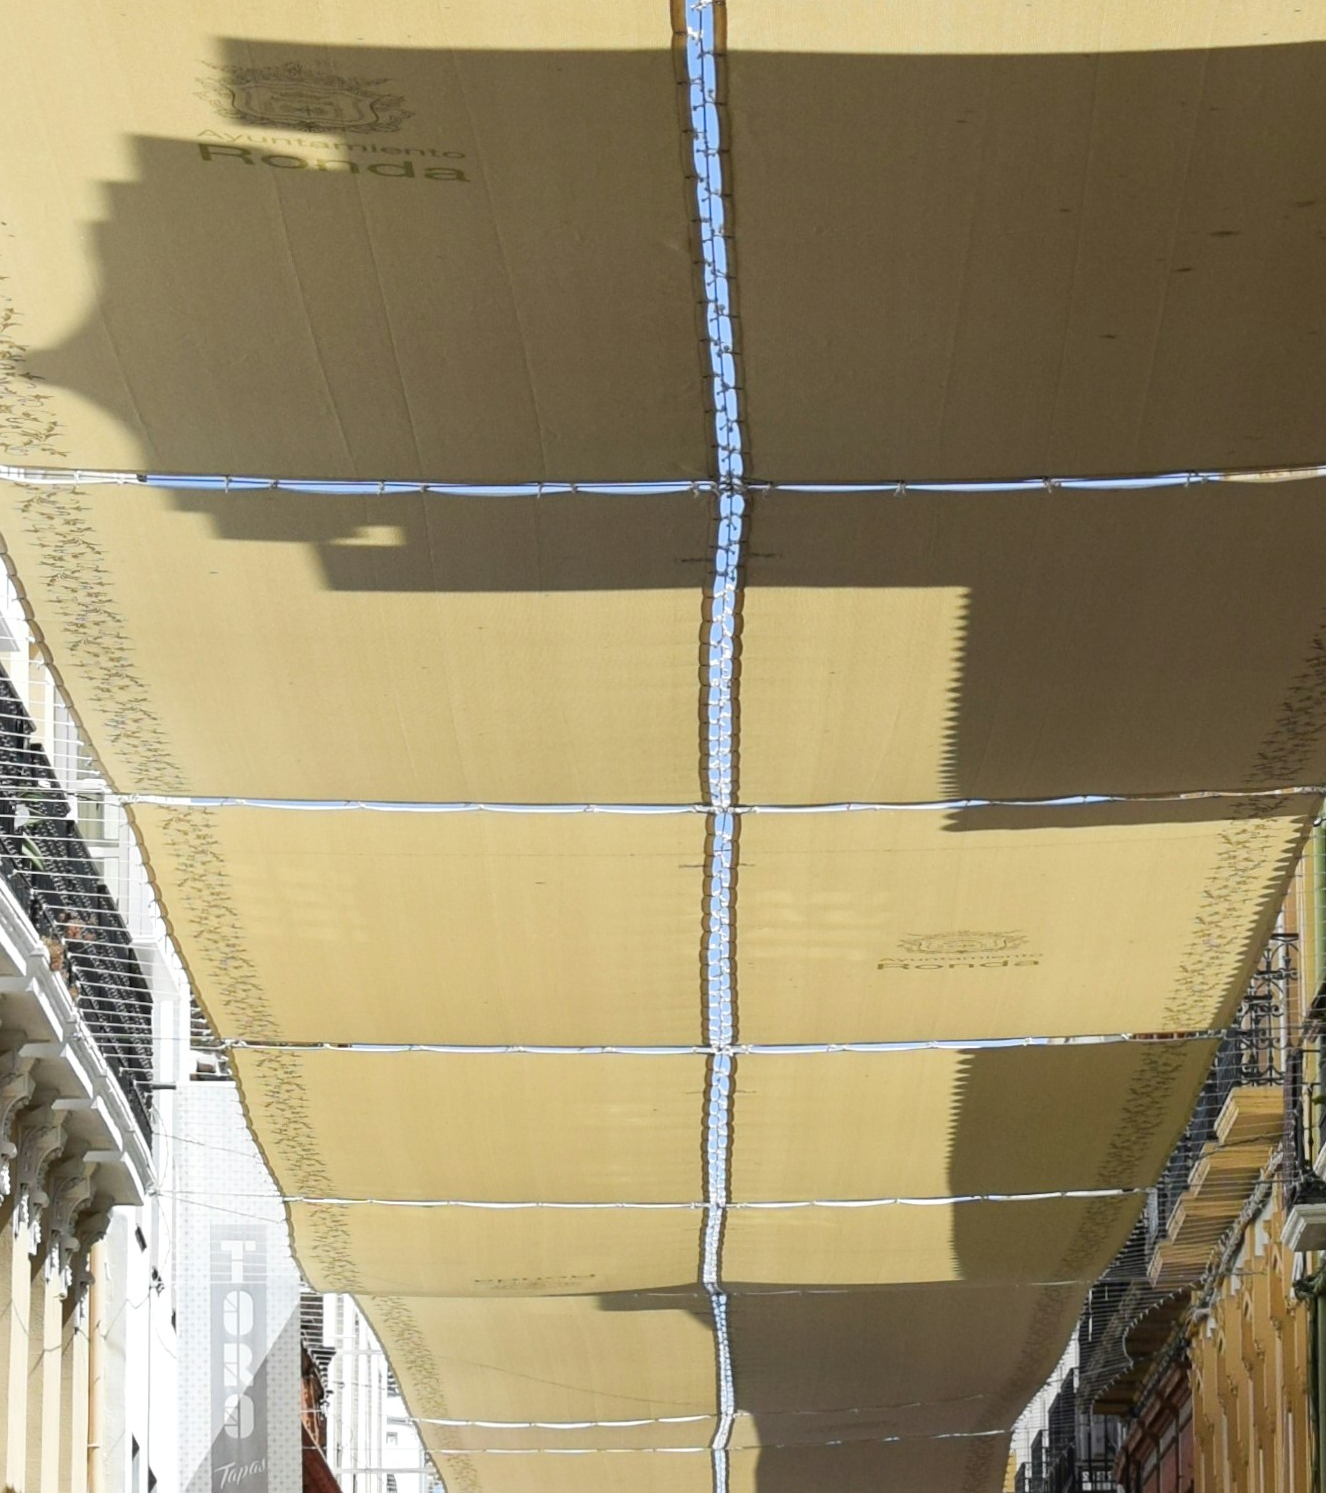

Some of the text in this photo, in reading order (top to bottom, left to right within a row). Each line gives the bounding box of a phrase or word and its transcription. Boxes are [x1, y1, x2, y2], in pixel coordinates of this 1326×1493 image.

[198, 129, 466, 159] Ayuntamiento
[198, 143, 471, 183] Ronda
[877, 960, 1040, 970] Ronda
[220, 1240, 255, 1439] TORO
[214, 1458, 265, 1489] Tapas
